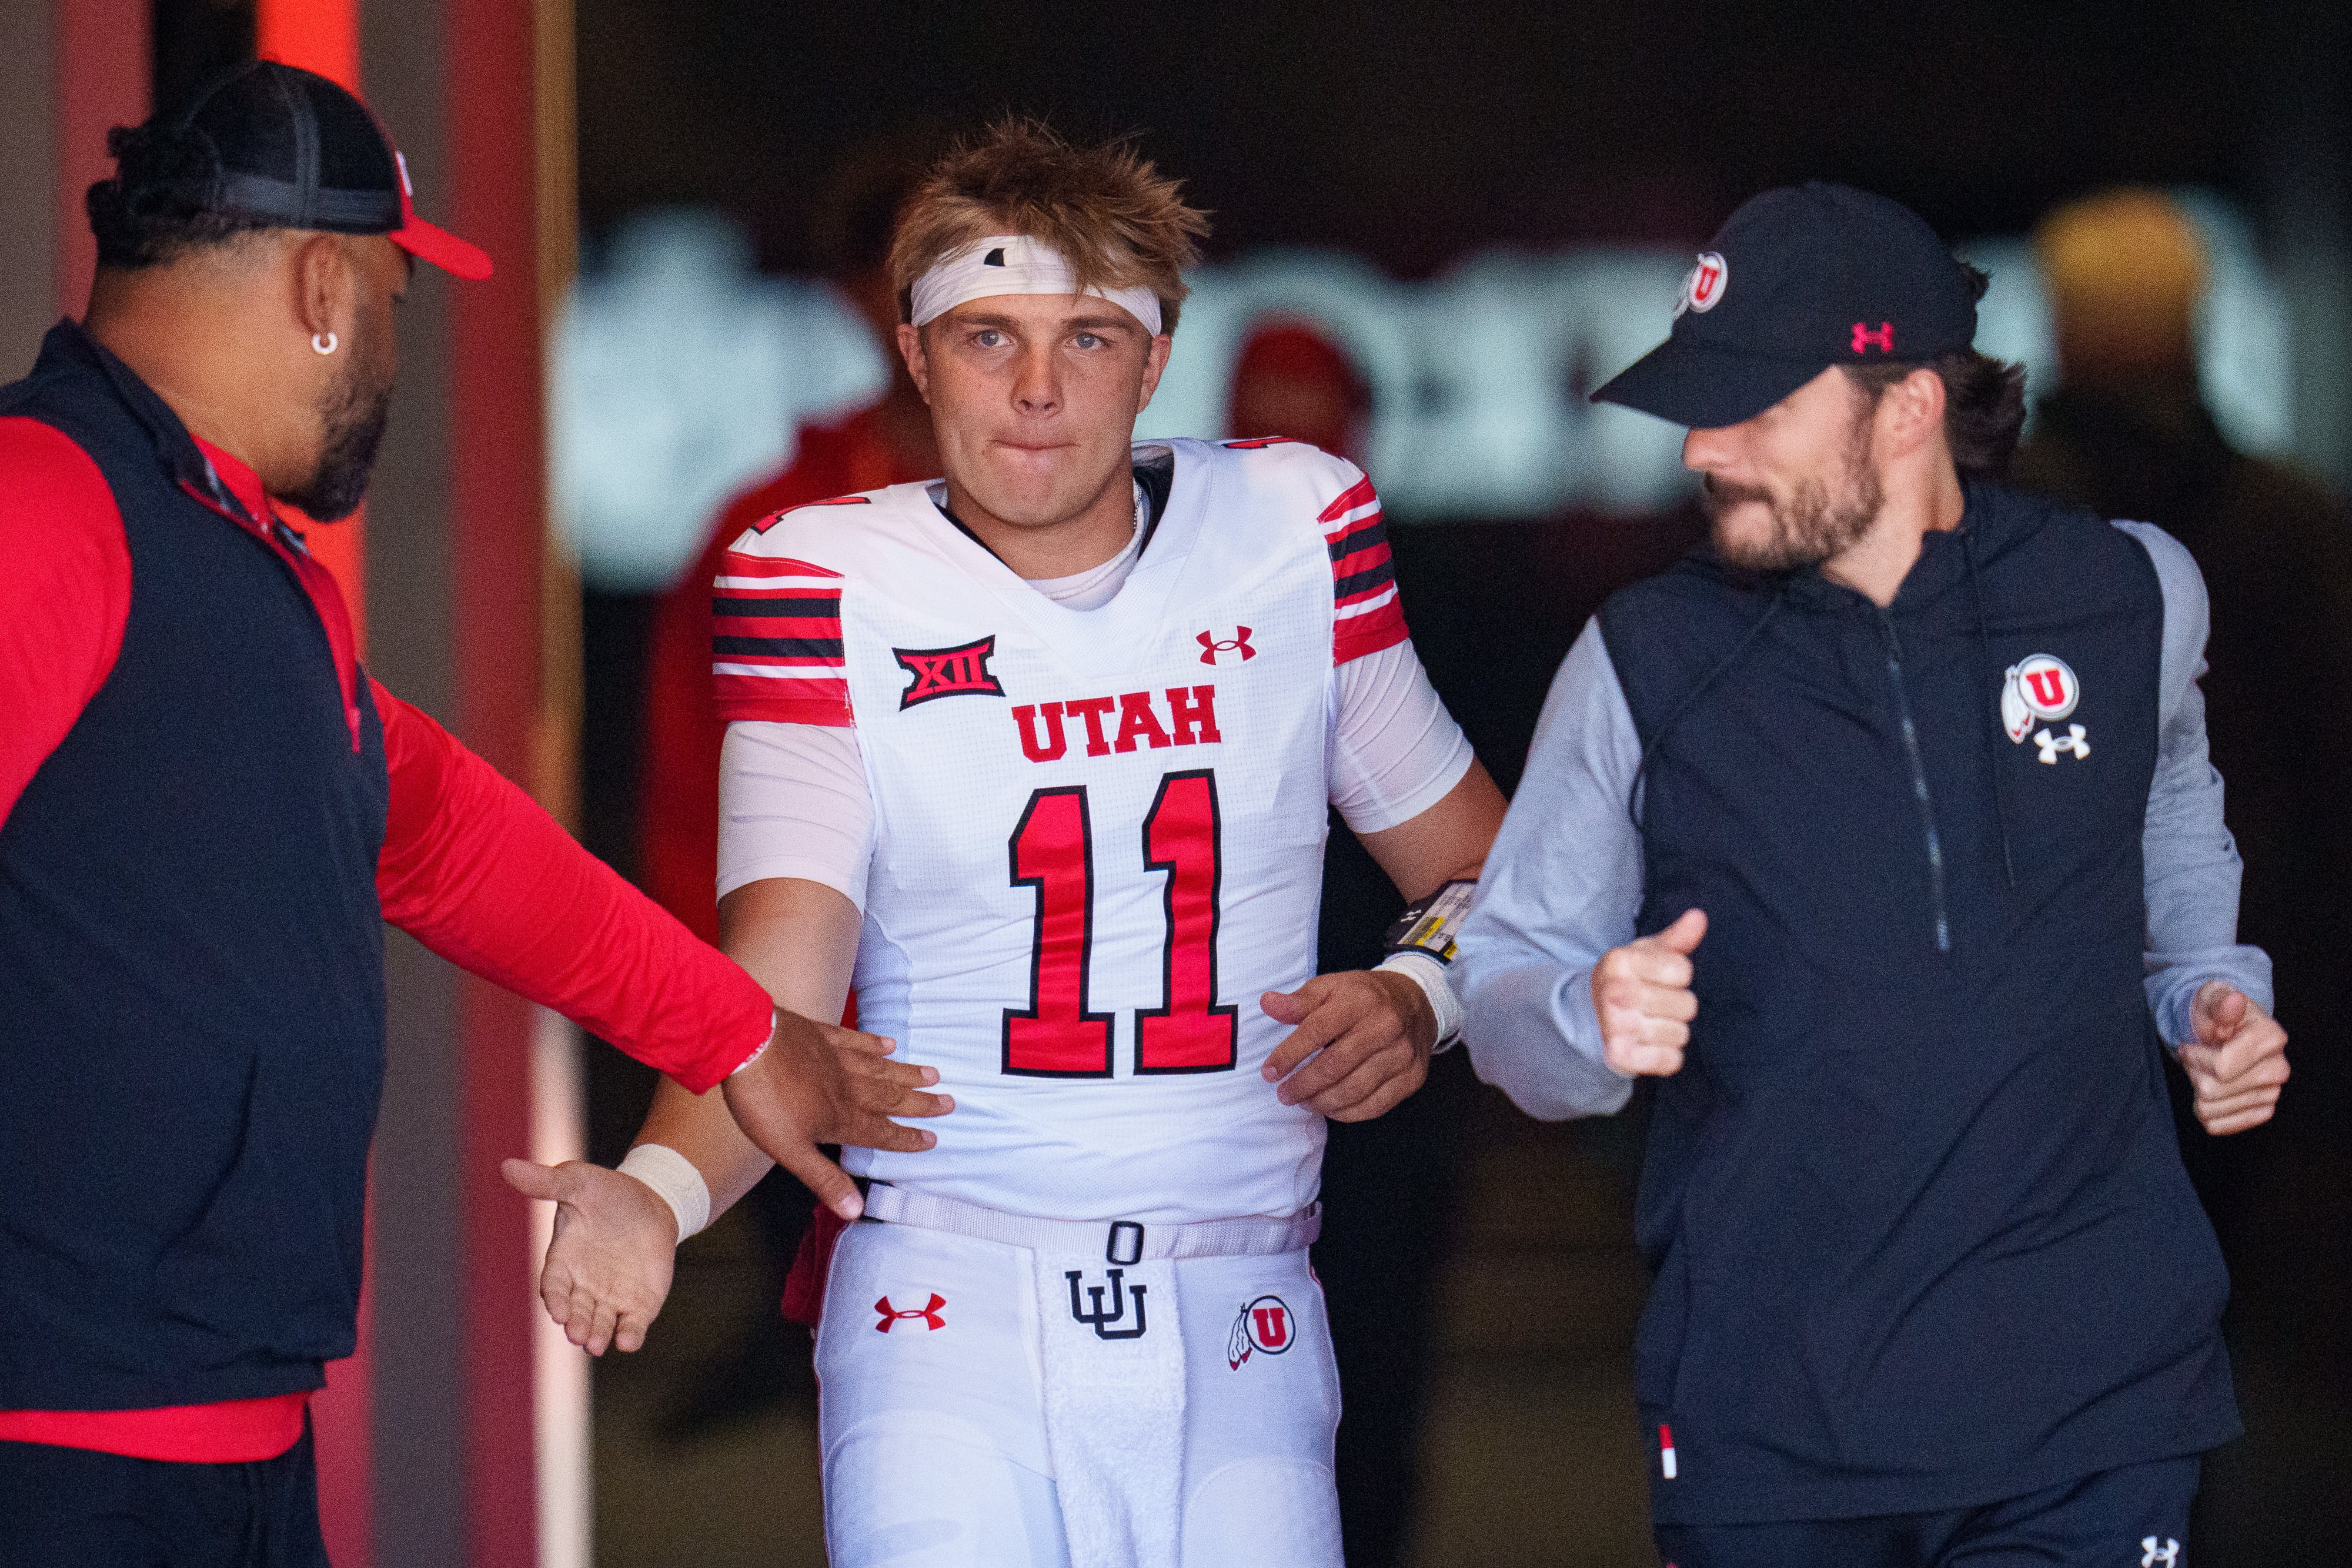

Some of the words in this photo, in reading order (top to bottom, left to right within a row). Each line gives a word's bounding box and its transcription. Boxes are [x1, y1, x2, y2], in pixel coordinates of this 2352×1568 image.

[1695, 265, 1719, 301] U
[2026, 668, 2066, 706] U
[1011, 684, 1222, 764] UTAH
[1001, 768, 1239, 1079] 11
[1253, 1306, 1285, 1348] U
